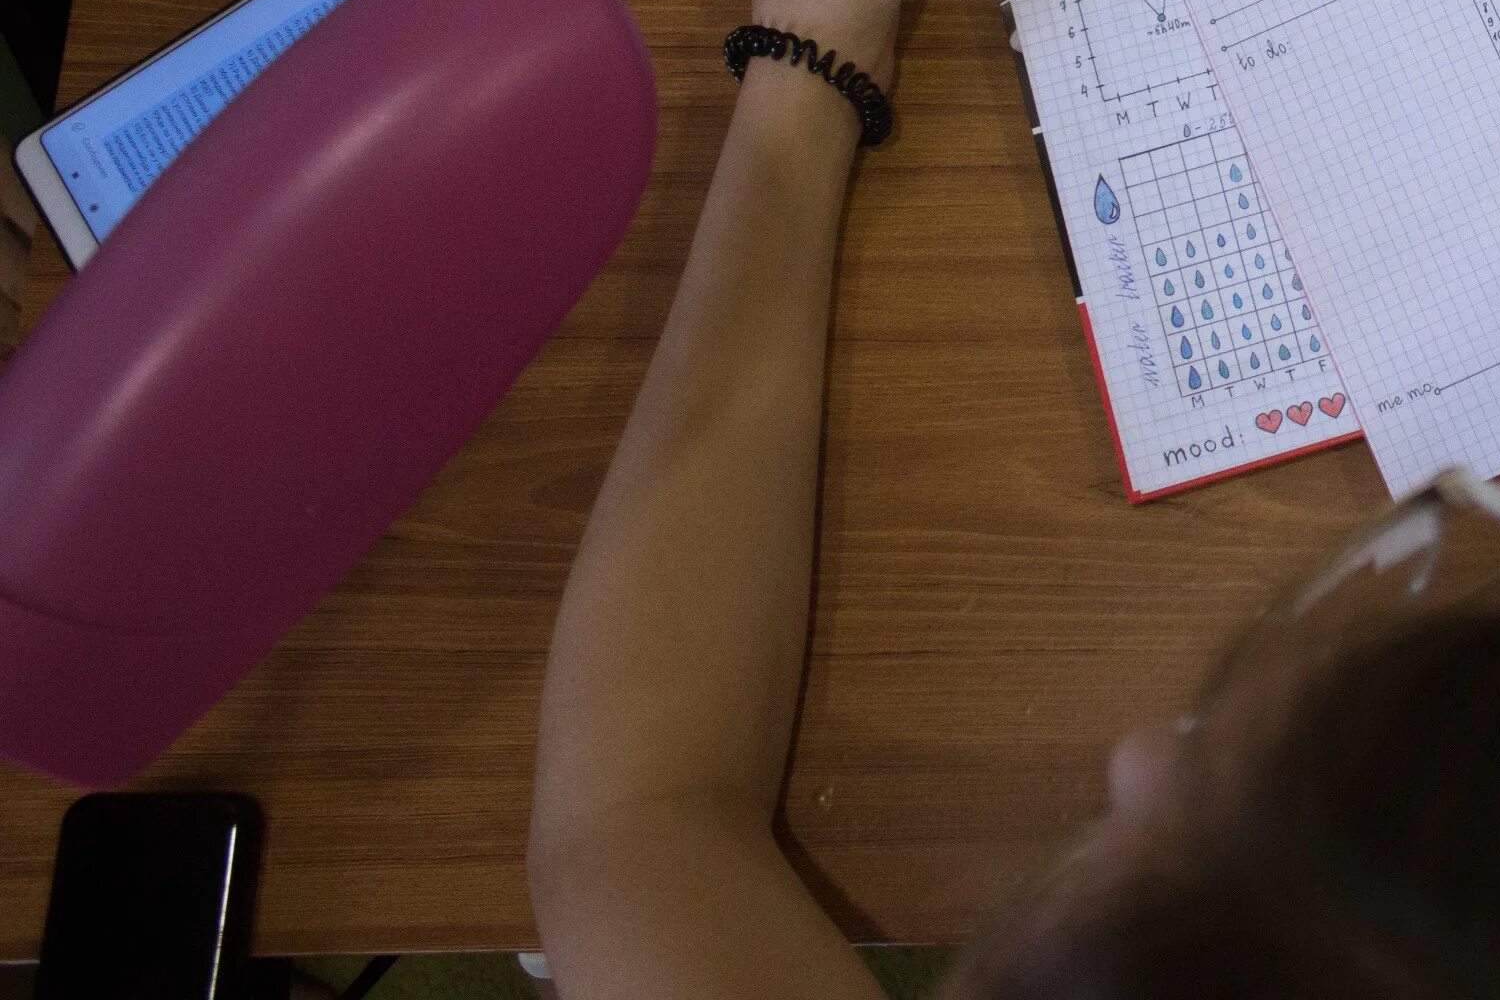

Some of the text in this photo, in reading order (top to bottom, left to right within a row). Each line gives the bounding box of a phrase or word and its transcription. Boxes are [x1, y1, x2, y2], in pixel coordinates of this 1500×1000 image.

[1481, 2, 1489, 14] 8
[1487, 17, 1494, 28] 9
[1238, 38, 1293, 71] to do:
[1080, 84, 1089, 98] 4
[1115, 83, 1220, 127] M T W T
[1109, 234, 1160, 388] water tracker
[1190, 359, 1328, 409] M T W T F
[1162, 425, 1246, 468] mood:
